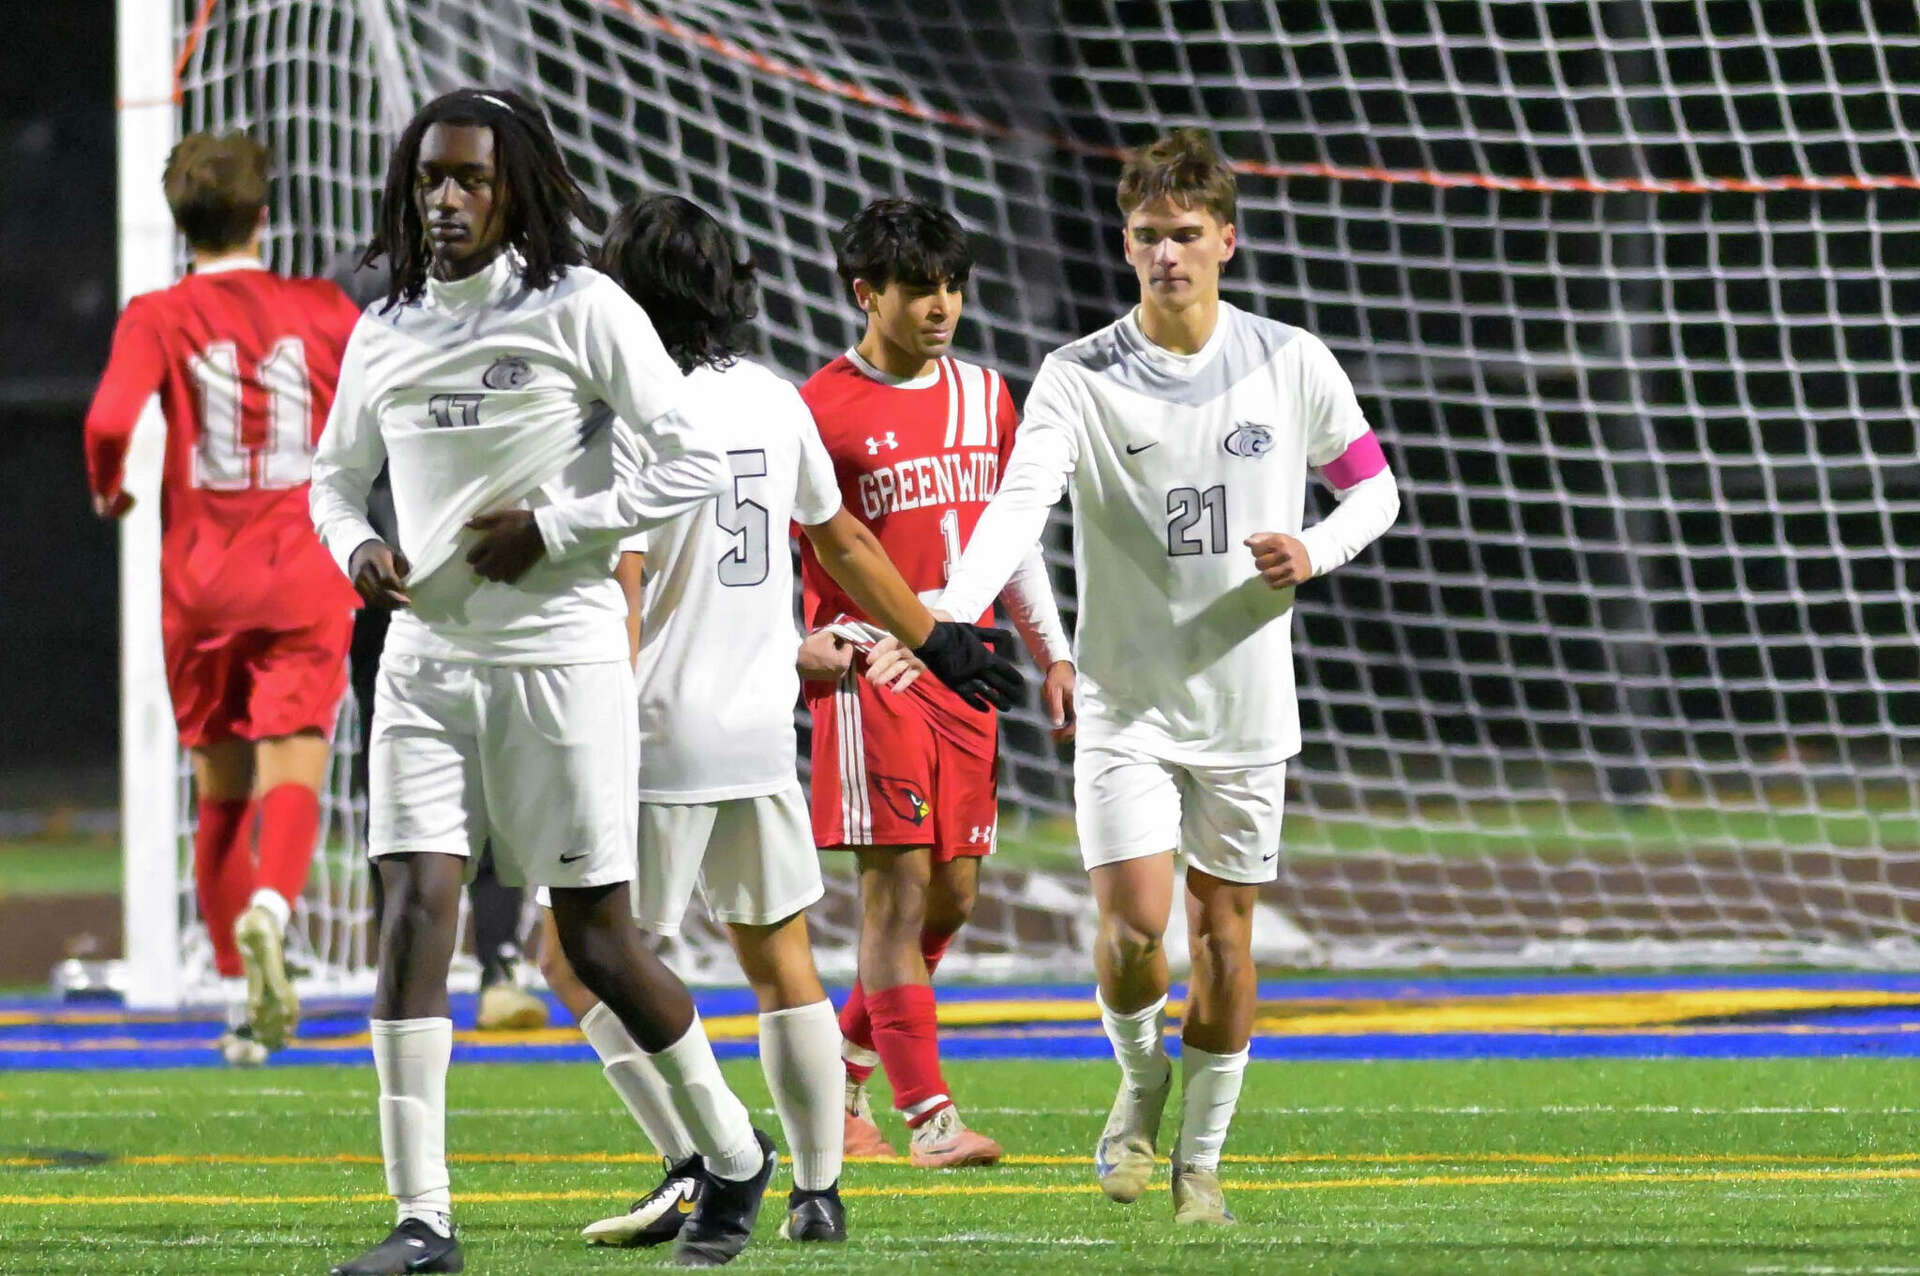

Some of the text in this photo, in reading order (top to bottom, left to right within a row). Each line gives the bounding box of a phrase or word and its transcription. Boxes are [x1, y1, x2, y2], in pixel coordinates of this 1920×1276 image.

[189, 337, 314, 490] 11
[428, 393, 485, 427] 17
[716, 448, 770, 588] 5
[1166, 485, 1229, 557] 21
